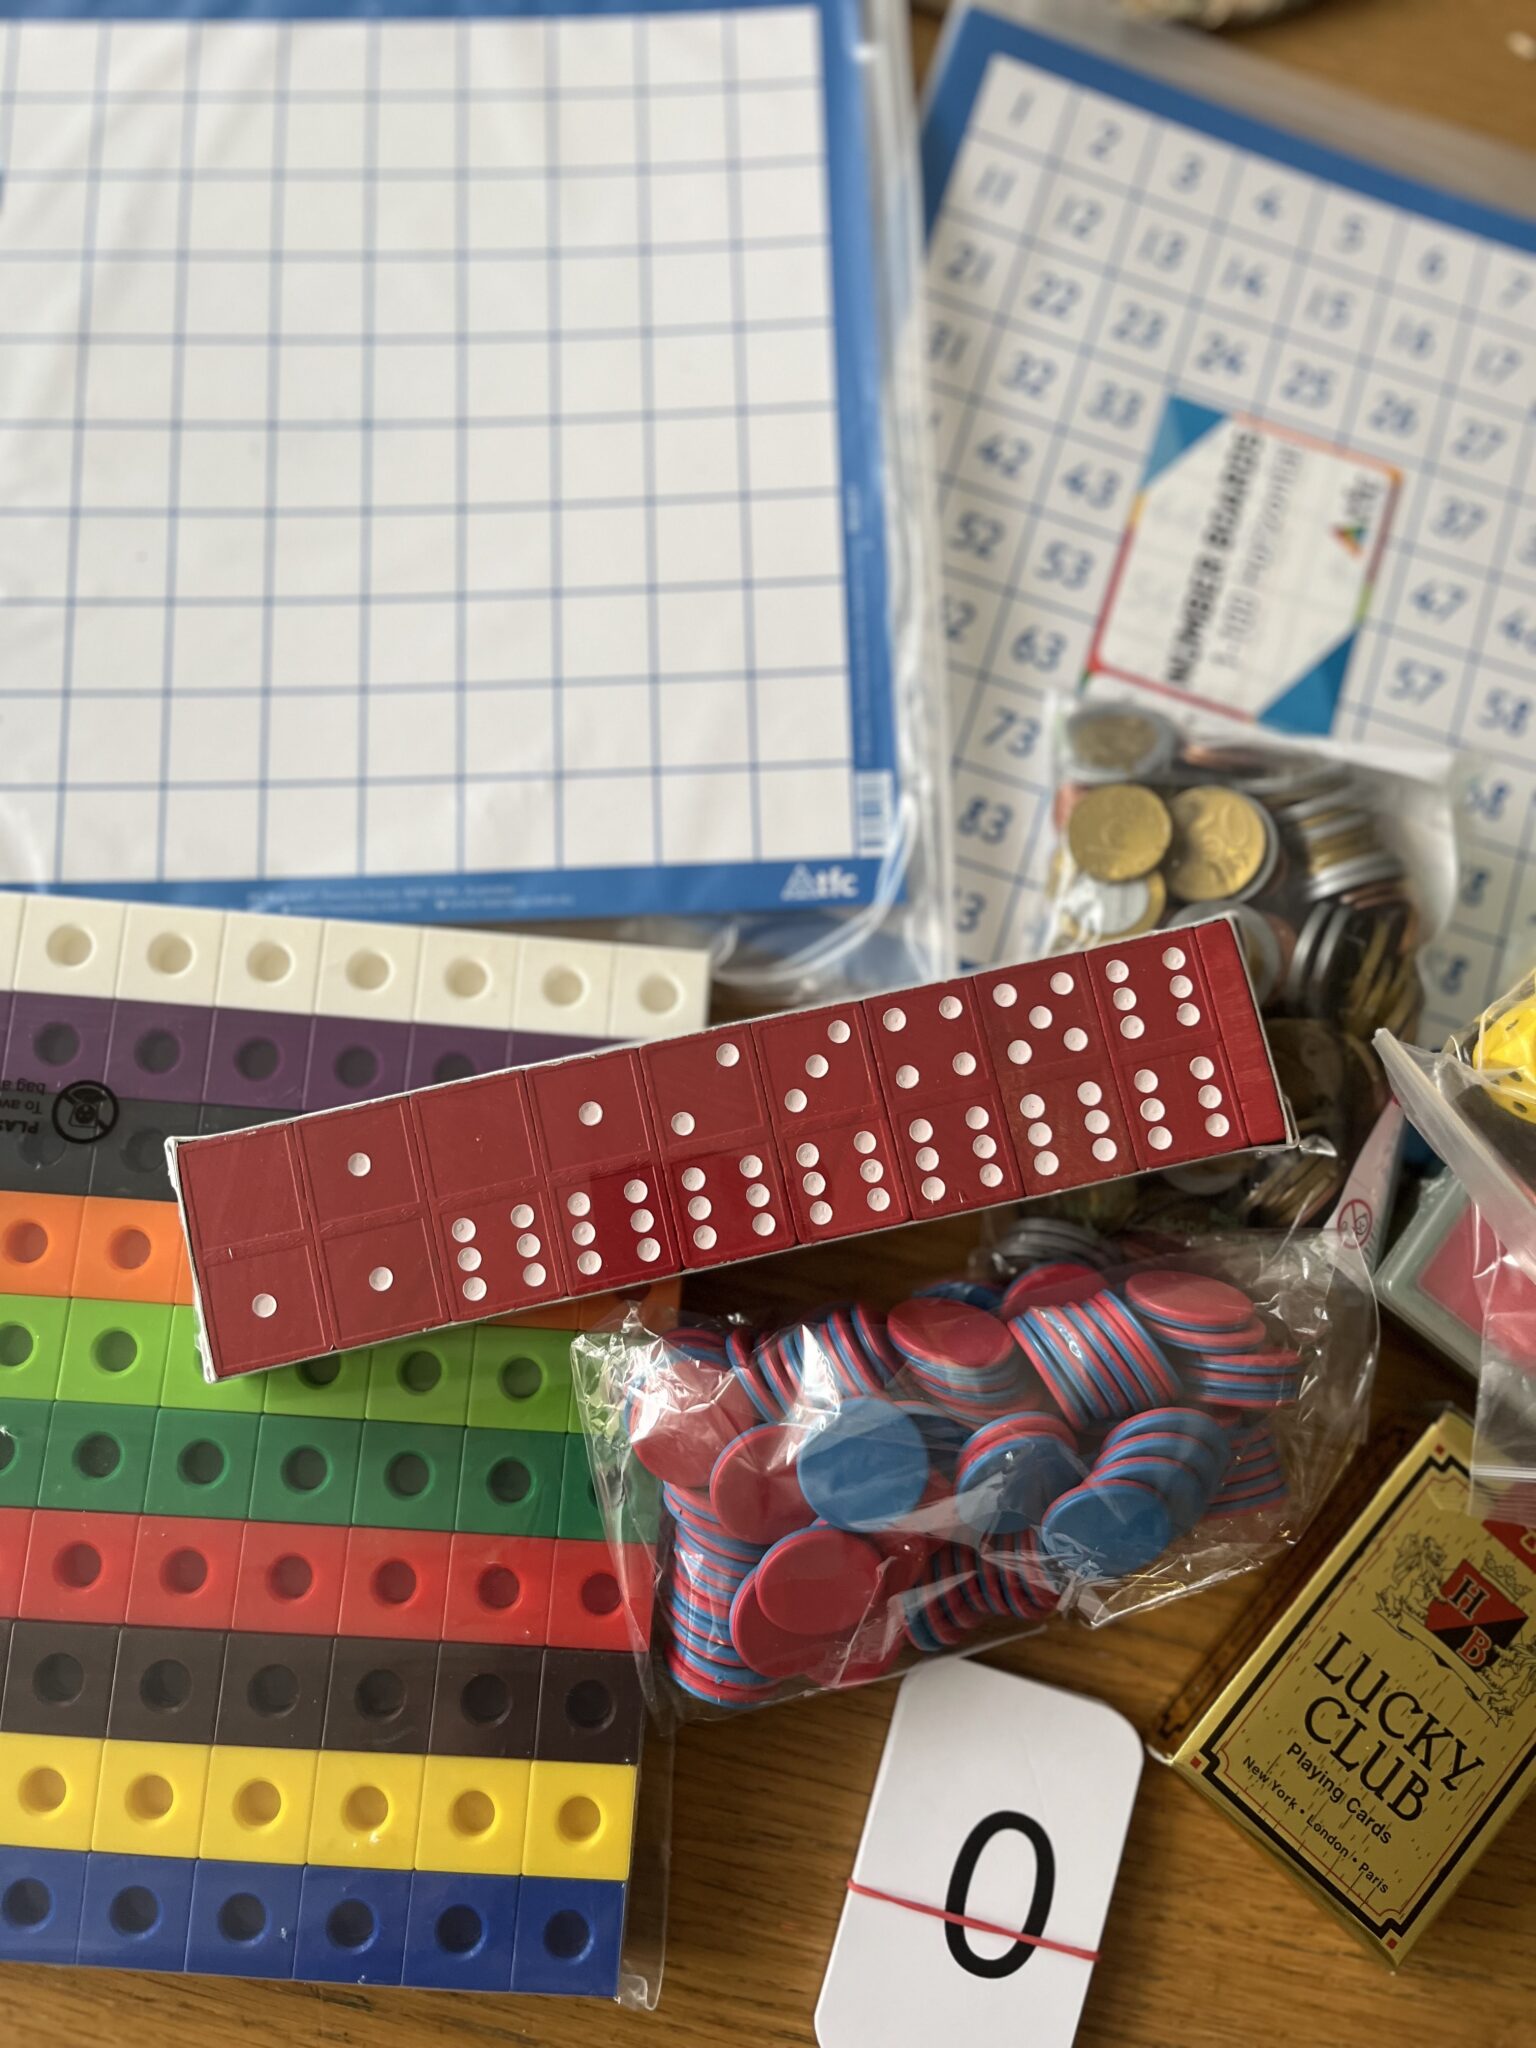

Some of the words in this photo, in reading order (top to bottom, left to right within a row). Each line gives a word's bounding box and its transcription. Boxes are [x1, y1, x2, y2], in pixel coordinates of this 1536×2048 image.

[1008, 89, 1035, 128] 1
[1088, 119, 1122, 163] 2
[1169, 152, 1205, 194] 3
[1332, 213, 1366, 255] 5
[974, 163, 1018, 206] 11
[1053, 196, 1104, 241] 12
[1135, 224, 1189, 272] 13
[1218, 257, 1271, 300] 14
[1303, 288, 1354, 331] 15
[1472, 341, 1523, 387] 17
[943, 239, 995, 288] 21
[1027, 271, 1083, 320] 22
[1111, 304, 1169, 350] 23
[1196, 331, 1247, 377] 24
[1281, 362, 1337, 408] 25
[1452, 415, 1510, 462] 27
[1000, 349, 1058, 398] 32
[1086, 381, 1145, 430] 33
[1430, 496, 1489, 542] 37
[1205, 431, 1262, 551] BOARDS
[977, 433, 1034, 479] 42
[1061, 461, 1121, 510] 43
[1410, 577, 1468, 622] 47
[942, 593, 977, 644] 2
[1010, 624, 1069, 673] 63
[946, 511, 1006, 560] 52
[1034, 541, 1095, 590] 53
[1389, 657, 1446, 704] 57
[1477, 685, 1534, 739] 58
[957, 796, 1013, 846] 83
[982, 705, 1041, 759] 73
[1460, 868, 1493, 908] 8
[815, 865, 860, 899] tfc
[952, 885, 985, 934] 3
[16, 1078, 46, 1096] bag
[24, 1101, 43, 1115] To
[1449, 1575, 1490, 1621] H
[1457, 1625, 1492, 1667] B
[1304, 1695, 1429, 1822] CLUB
[1313, 1631, 1485, 1791] LUCKY
[1242, 1755, 1270, 1783] New
[1270, 1779, 1298, 1810] York
[1306, 1814, 1349, 1858] London
[1358, 1862, 1389, 1894] Paris
[1286, 1742, 1345, 1803] Playing
[1346, 1797, 1392, 1844] Cards
[944, 1810, 1056, 1979] 0
